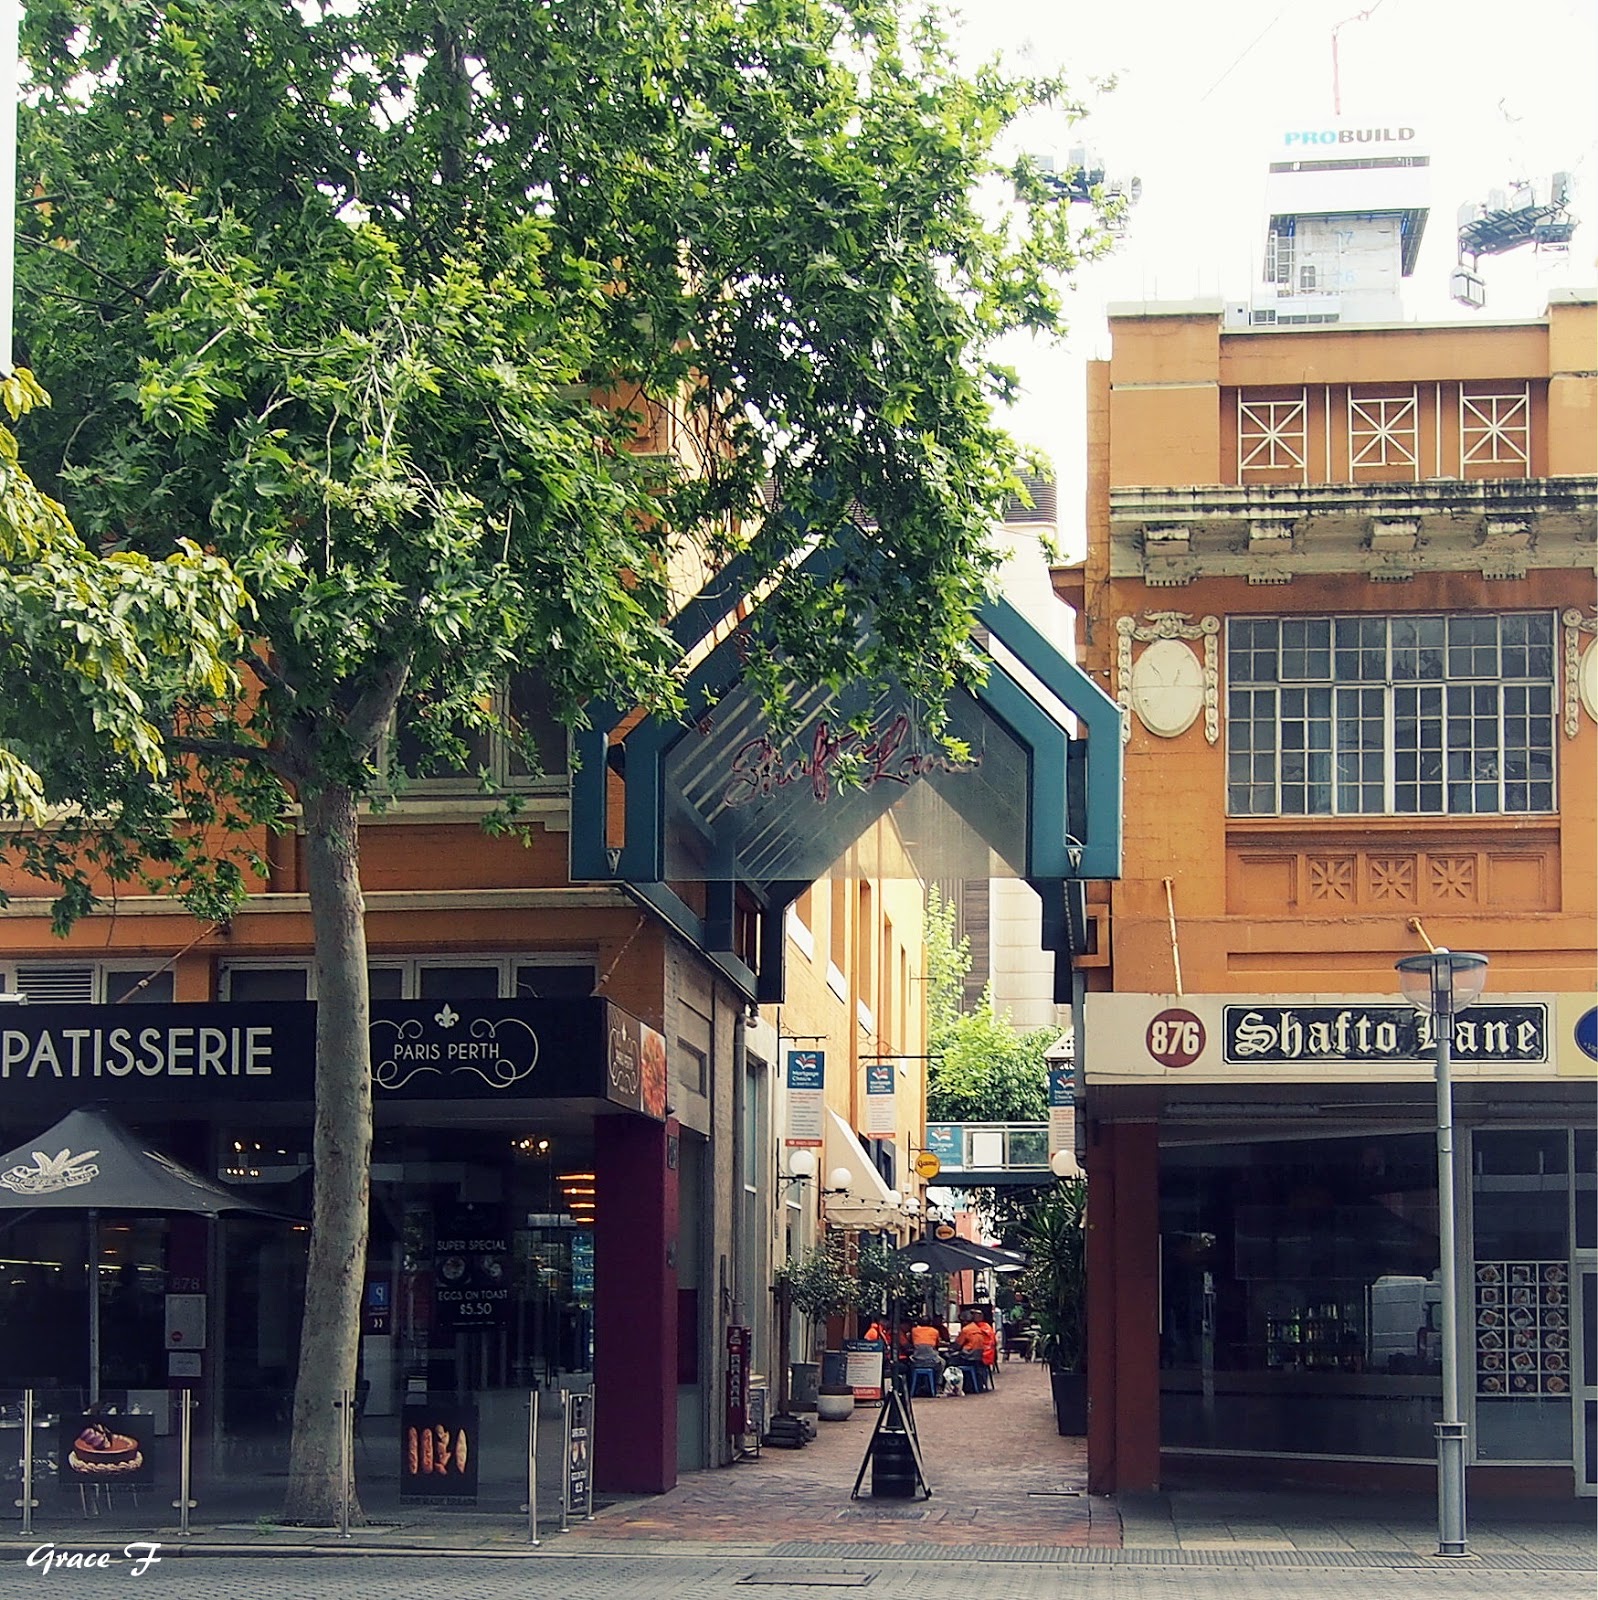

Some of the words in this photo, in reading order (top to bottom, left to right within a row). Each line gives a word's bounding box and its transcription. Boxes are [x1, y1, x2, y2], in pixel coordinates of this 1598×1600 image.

[1284, 127, 1416, 146] PROBUILD
[1151, 1021, 1201, 1056] 876
[1234, 1011, 1398, 1059] Shafto
[1413, 1009, 1538, 1057] Lane
[1, 1027, 273, 1078] PATISSERIE
[393, 1043, 441, 1061] PARIS
[447, 1042, 500, 1060] PERTH
[436, 1239, 466, 1251] SUPER
[468, 1239, 508, 1251] SPECIAL
[464, 1290, 479, 1300] ON
[480, 1288, 509, 1300] TOAST
[459, 1302, 493, 1316] $5.50
